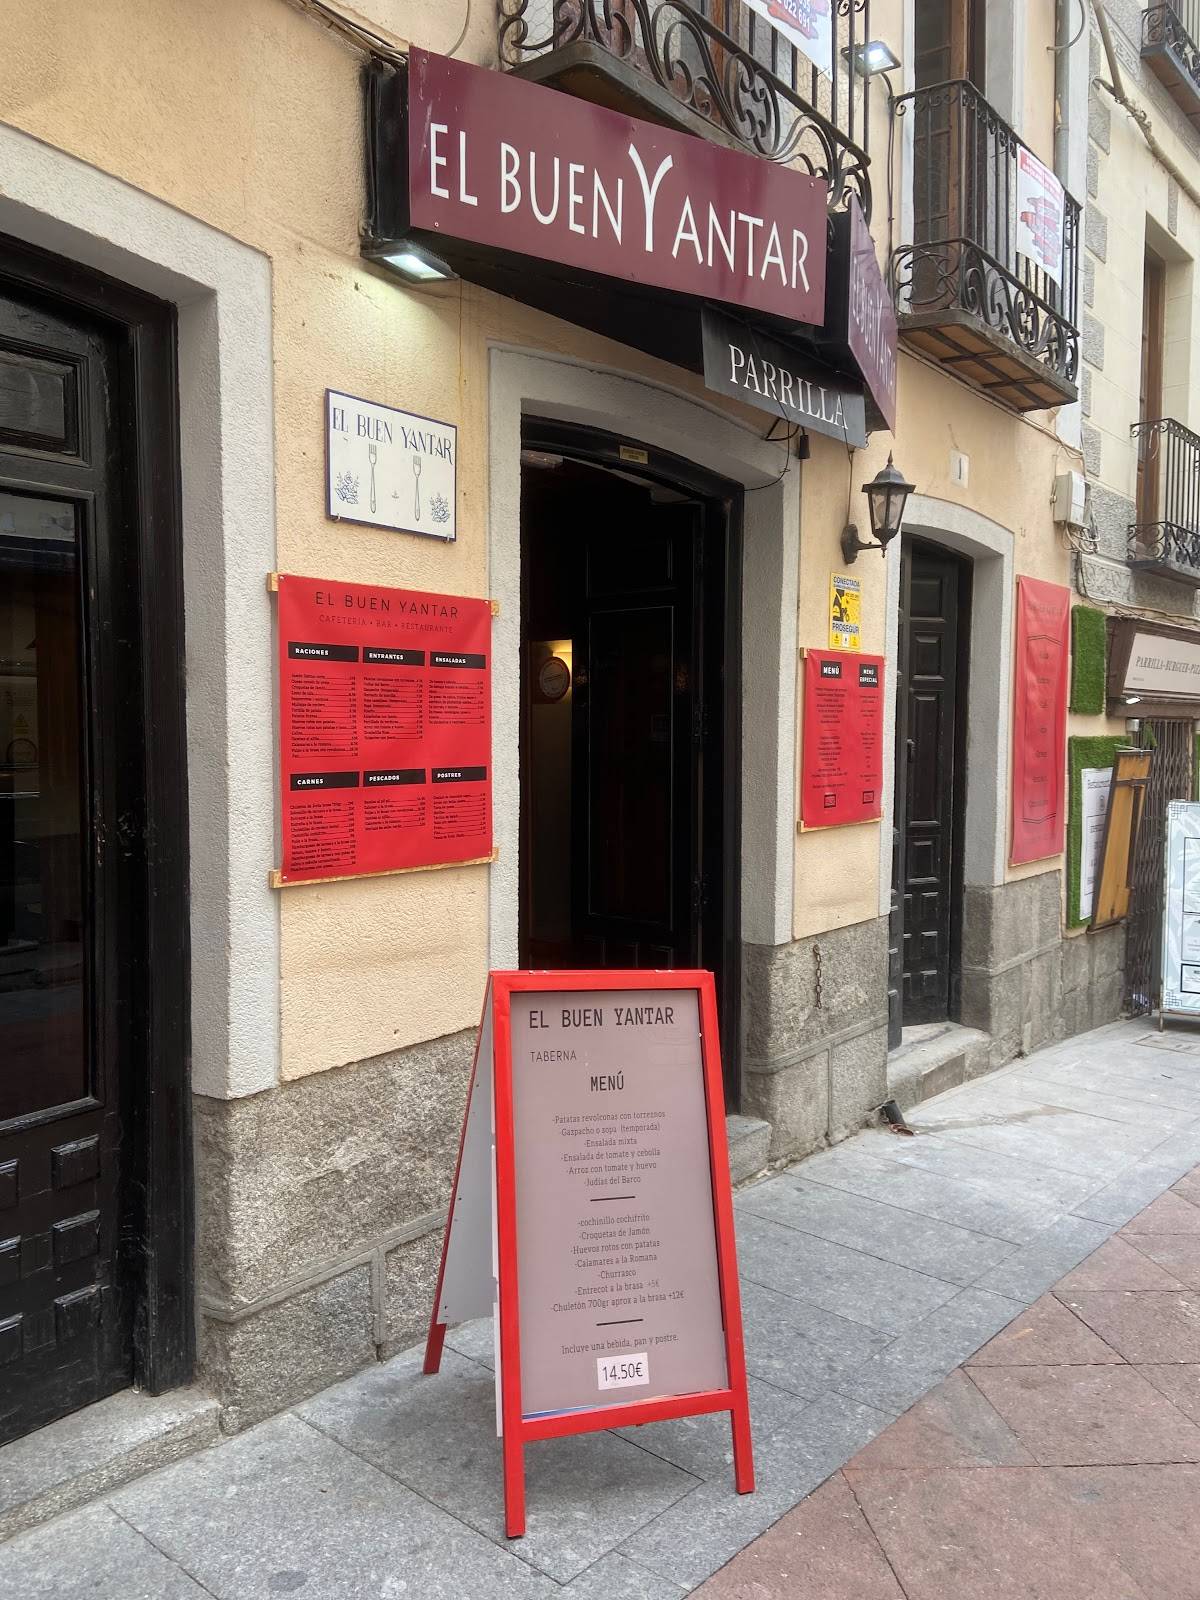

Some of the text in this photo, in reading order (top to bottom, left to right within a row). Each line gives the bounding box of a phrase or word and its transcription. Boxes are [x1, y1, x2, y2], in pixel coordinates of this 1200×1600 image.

[429, 122, 811, 294] EL BUEN YANTAR
[728, 343, 849, 430] PARRILLA
[332, 407, 454, 465] EL BUEN YANTAR
[315, 591, 459, 619] EL BUEN YANTAR
[401, 622, 454, 634] RESTAURANTE
[832, 622, 860, 635] PROSEGUR
[295, 647, 329, 656] RACIONES
[368, 652, 404, 661] ENTRANTES
[435, 656, 466, 664] ENSALADAS
[823, 666, 840, 675] MENÚ
[368, 774, 400, 782] PESCADOS
[437, 771, 462, 779] POSTRES
[296, 777, 324, 786] CARNES
[529, 1006, 675, 1029] EL BUEN YANTAR
[530, 1050, 577, 1063] TABERNA
[590, 1071, 625, 1092] MENÚ
[618, 1138, 637, 1146] mixta
[595, 1152, 604, 1160] de
[606, 1150, 629, 1159] tomate
[637, 1148, 661, 1157] cebolla
[604, 1163, 628, 1172] tomate
[636, 1161, 657, 1170] huevo
[609, 1176, 620, 1185] del
[621, 1175, 641, 1184] Barco
[618, 1228, 627, 1237] de
[601, 1242, 620, 1252] rotos
[621, 1241, 634, 1251] con
[635, 1239, 660, 1250] patatas
[621, 1254, 628, 1264] la
[629, 1253, 658, 1262] Romana
[616, 1282, 623, 1291] la
[624, 1280, 644, 1290] brasa
[588, 1298, 610, 1309] 700gr
[611, 1298, 632, 1308] aprox
[639, 1294, 646, 1303] la
[647, 1292, 667, 1303] brasa
[667, 1290, 685, 1300] +12€
[561, 1344, 590, 1355] Incluye
[591, 1343, 605, 1351] una
[634, 1338, 647, 1348] pan
[648, 1337, 654, 1345] y
[602, 1361, 643, 1382] 14.50€
